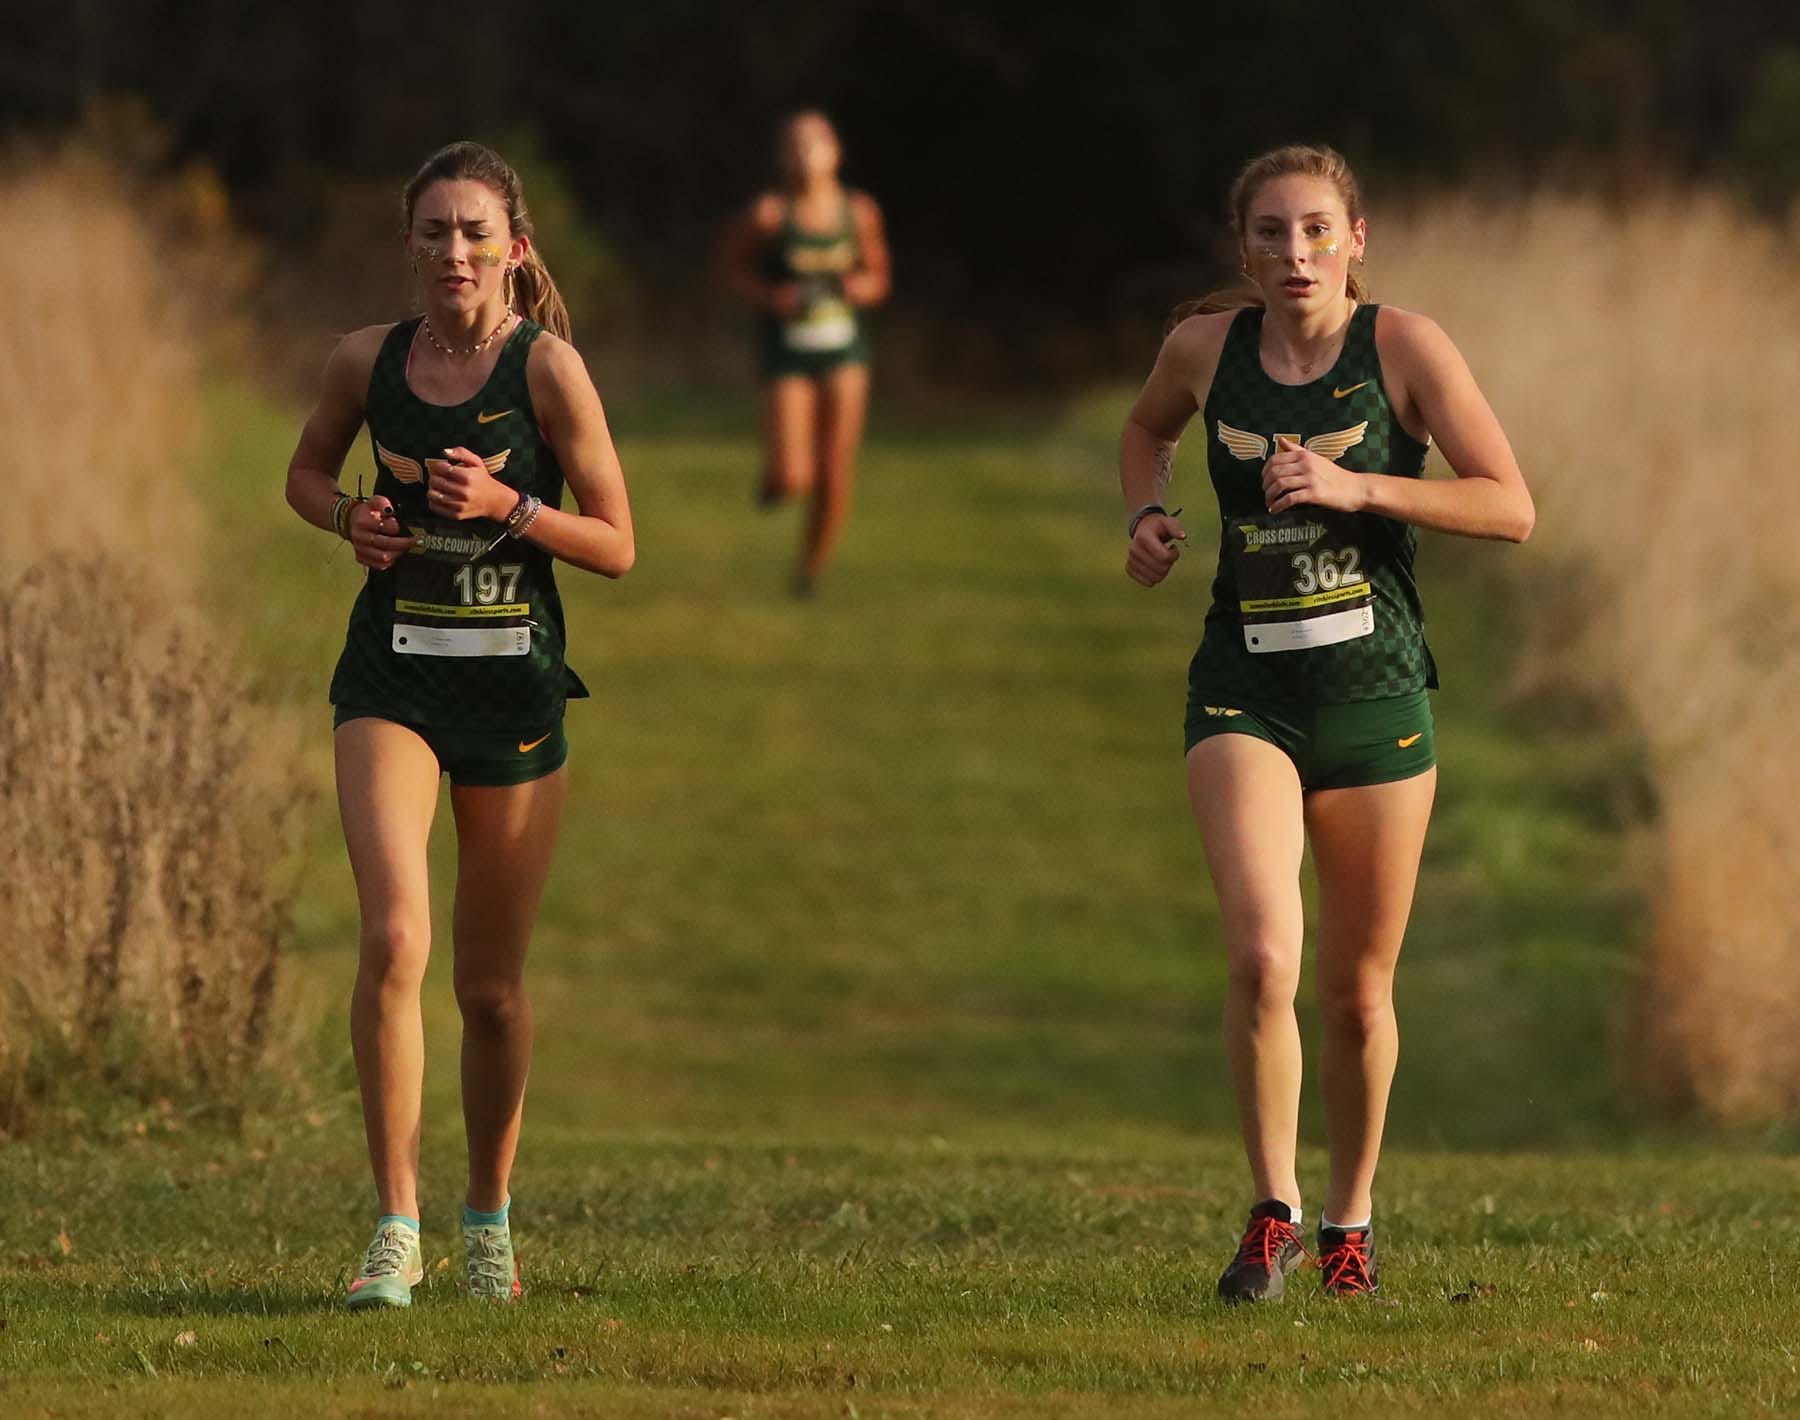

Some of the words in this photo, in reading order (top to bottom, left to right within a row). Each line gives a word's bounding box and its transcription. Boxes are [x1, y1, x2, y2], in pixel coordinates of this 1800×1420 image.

[1246, 528, 1276, 545] CROSS
[1278, 522, 1323, 543] COUNTRY
[453, 563, 522, 606] 197
[1291, 546, 1364, 595] 362
